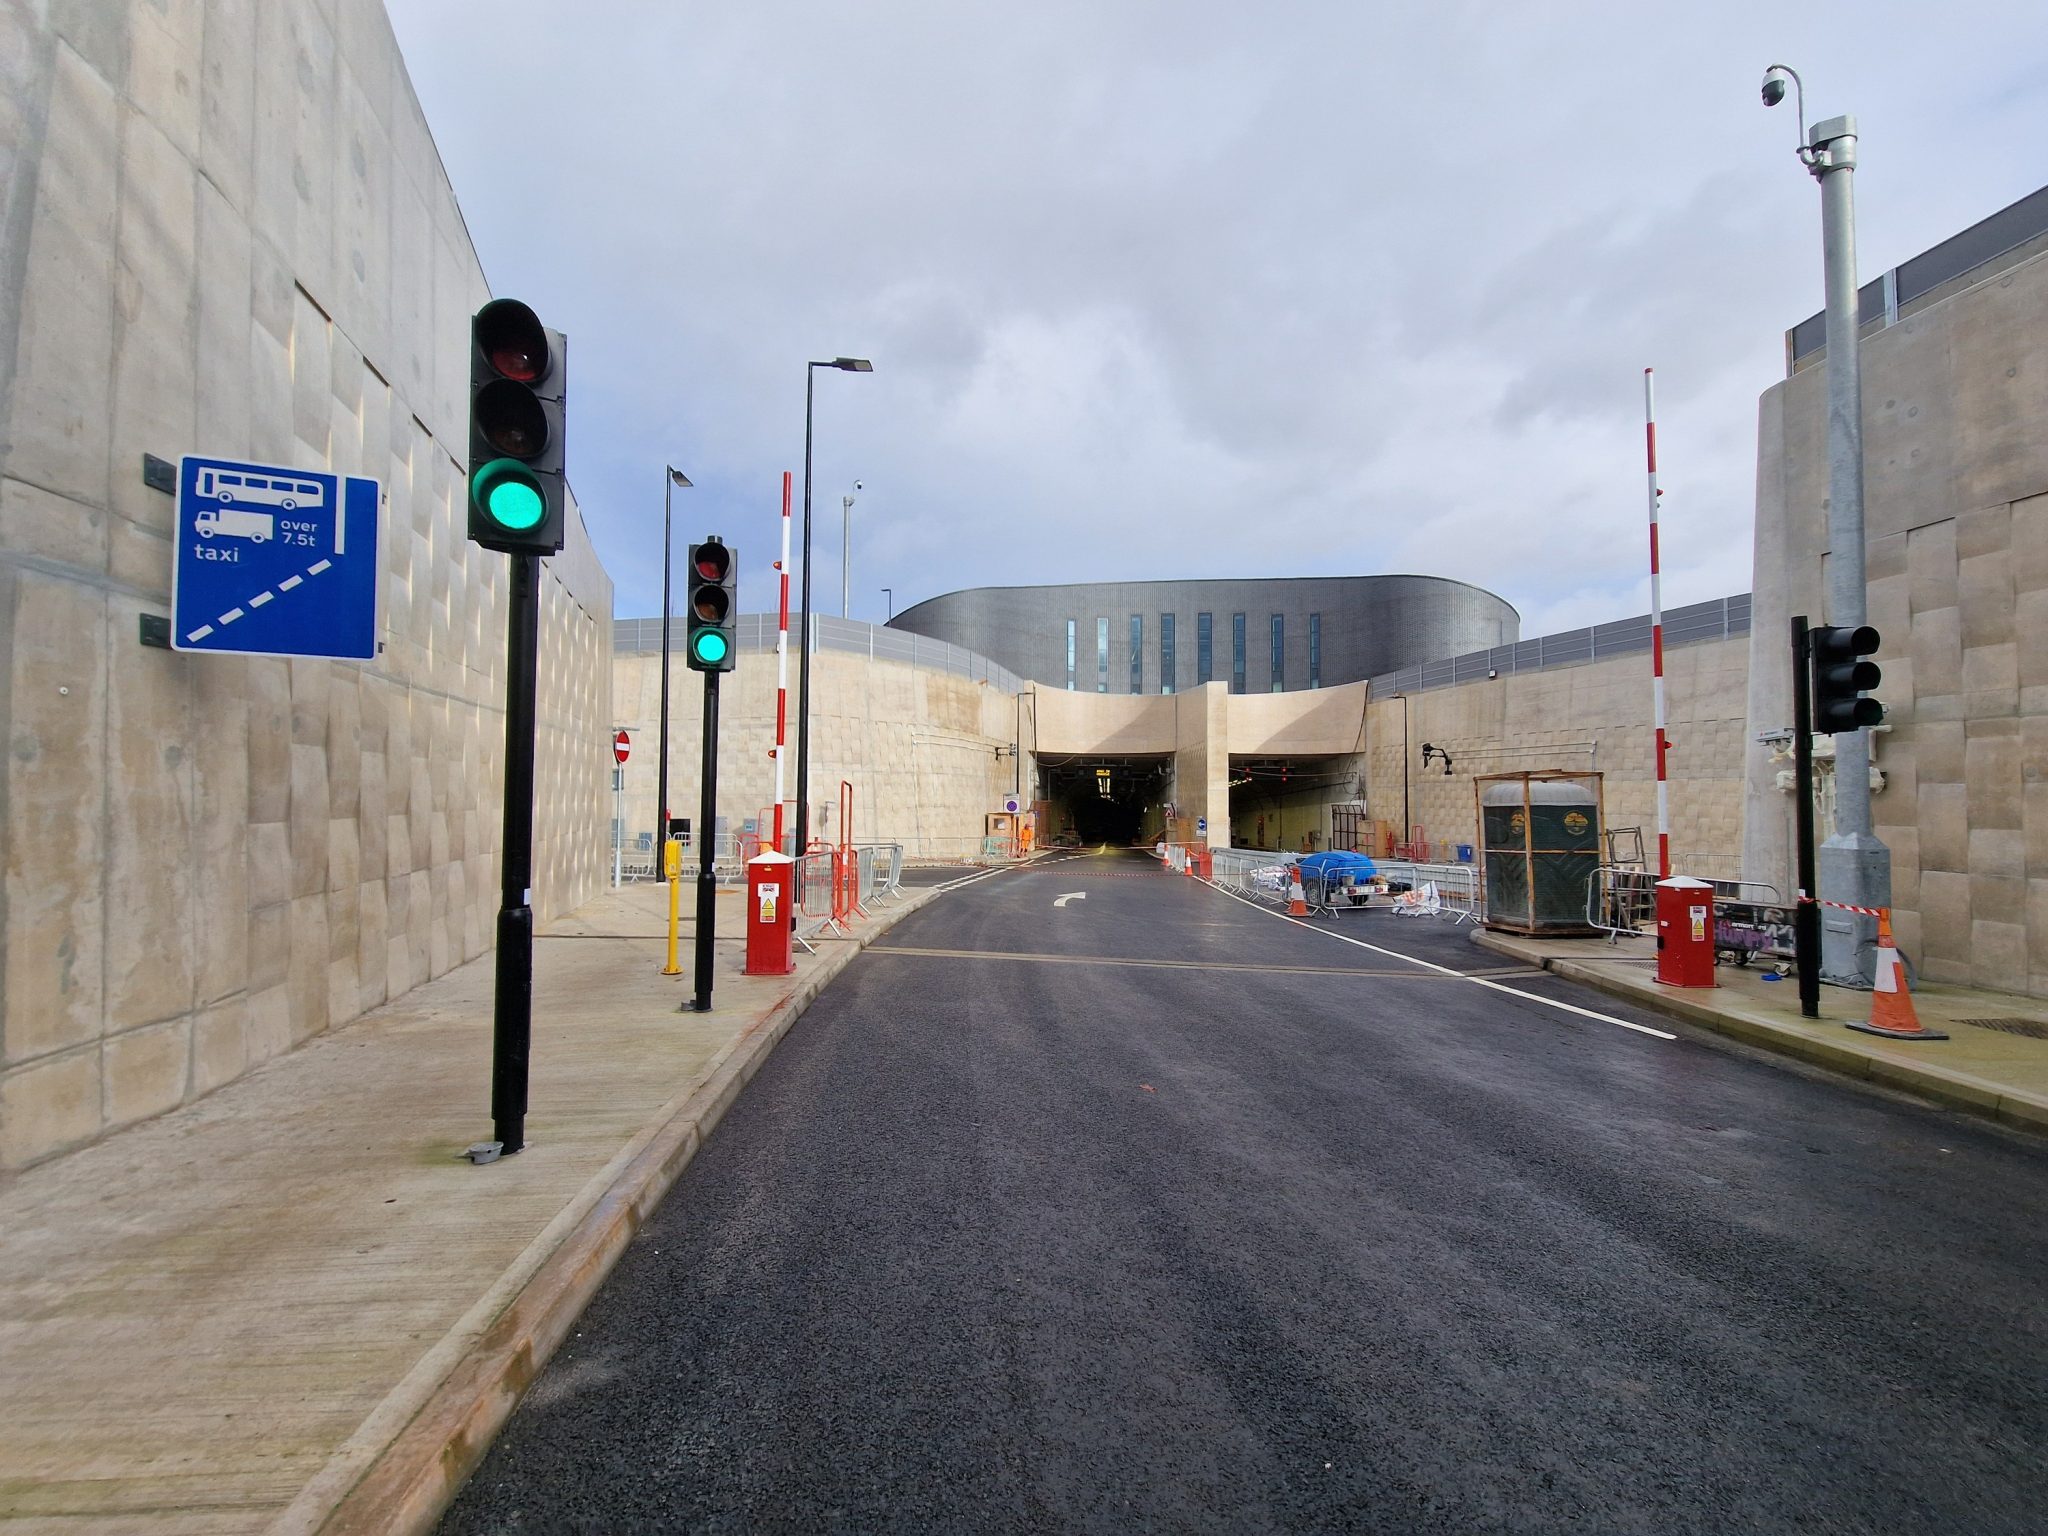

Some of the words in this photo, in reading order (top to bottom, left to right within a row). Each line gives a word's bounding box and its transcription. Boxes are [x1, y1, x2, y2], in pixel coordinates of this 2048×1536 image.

[280, 520, 318, 533] over
[281, 532, 316, 547] 7.5t
[194, 543, 239, 562] taxi
